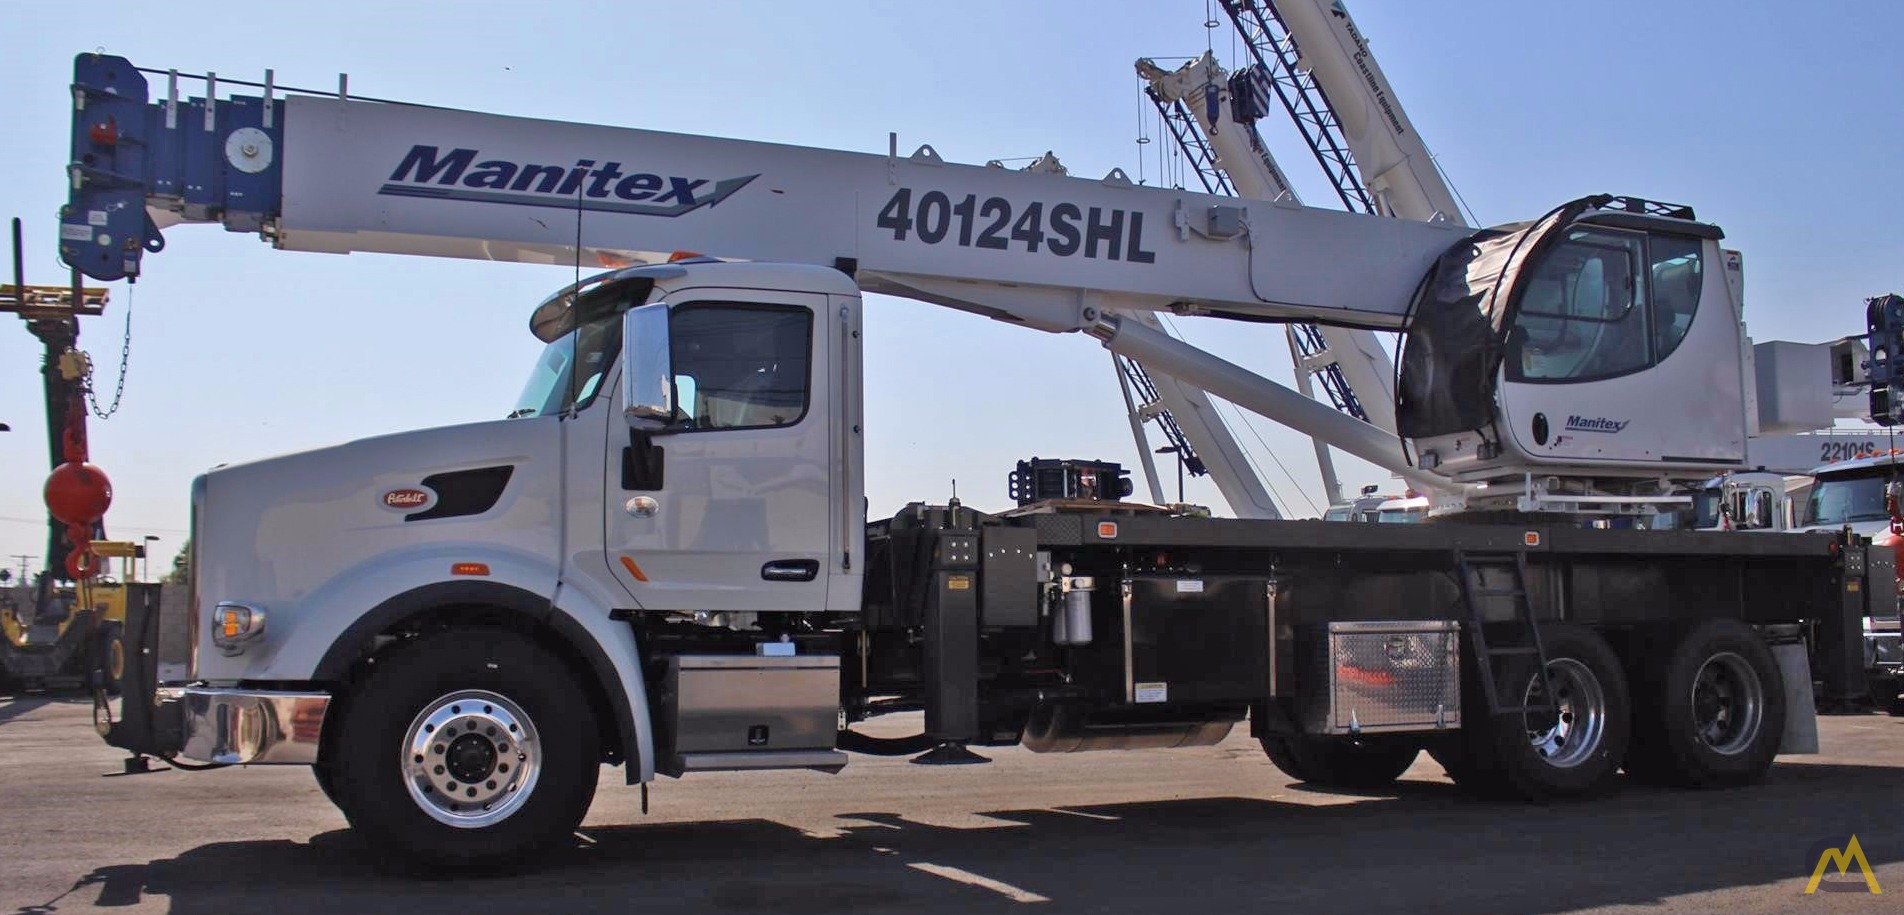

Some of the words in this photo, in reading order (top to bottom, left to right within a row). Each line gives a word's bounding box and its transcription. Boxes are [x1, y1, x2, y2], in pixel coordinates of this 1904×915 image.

[1345, 21, 1368, 58] TADANO
[1353, 51, 1380, 93] Coastline
[1376, 90, 1404, 136] Equipment
[389, 144, 709, 206] Manitex
[876, 187, 1156, 264] 40124SHL
[1566, 415, 1622, 431] Manitex
